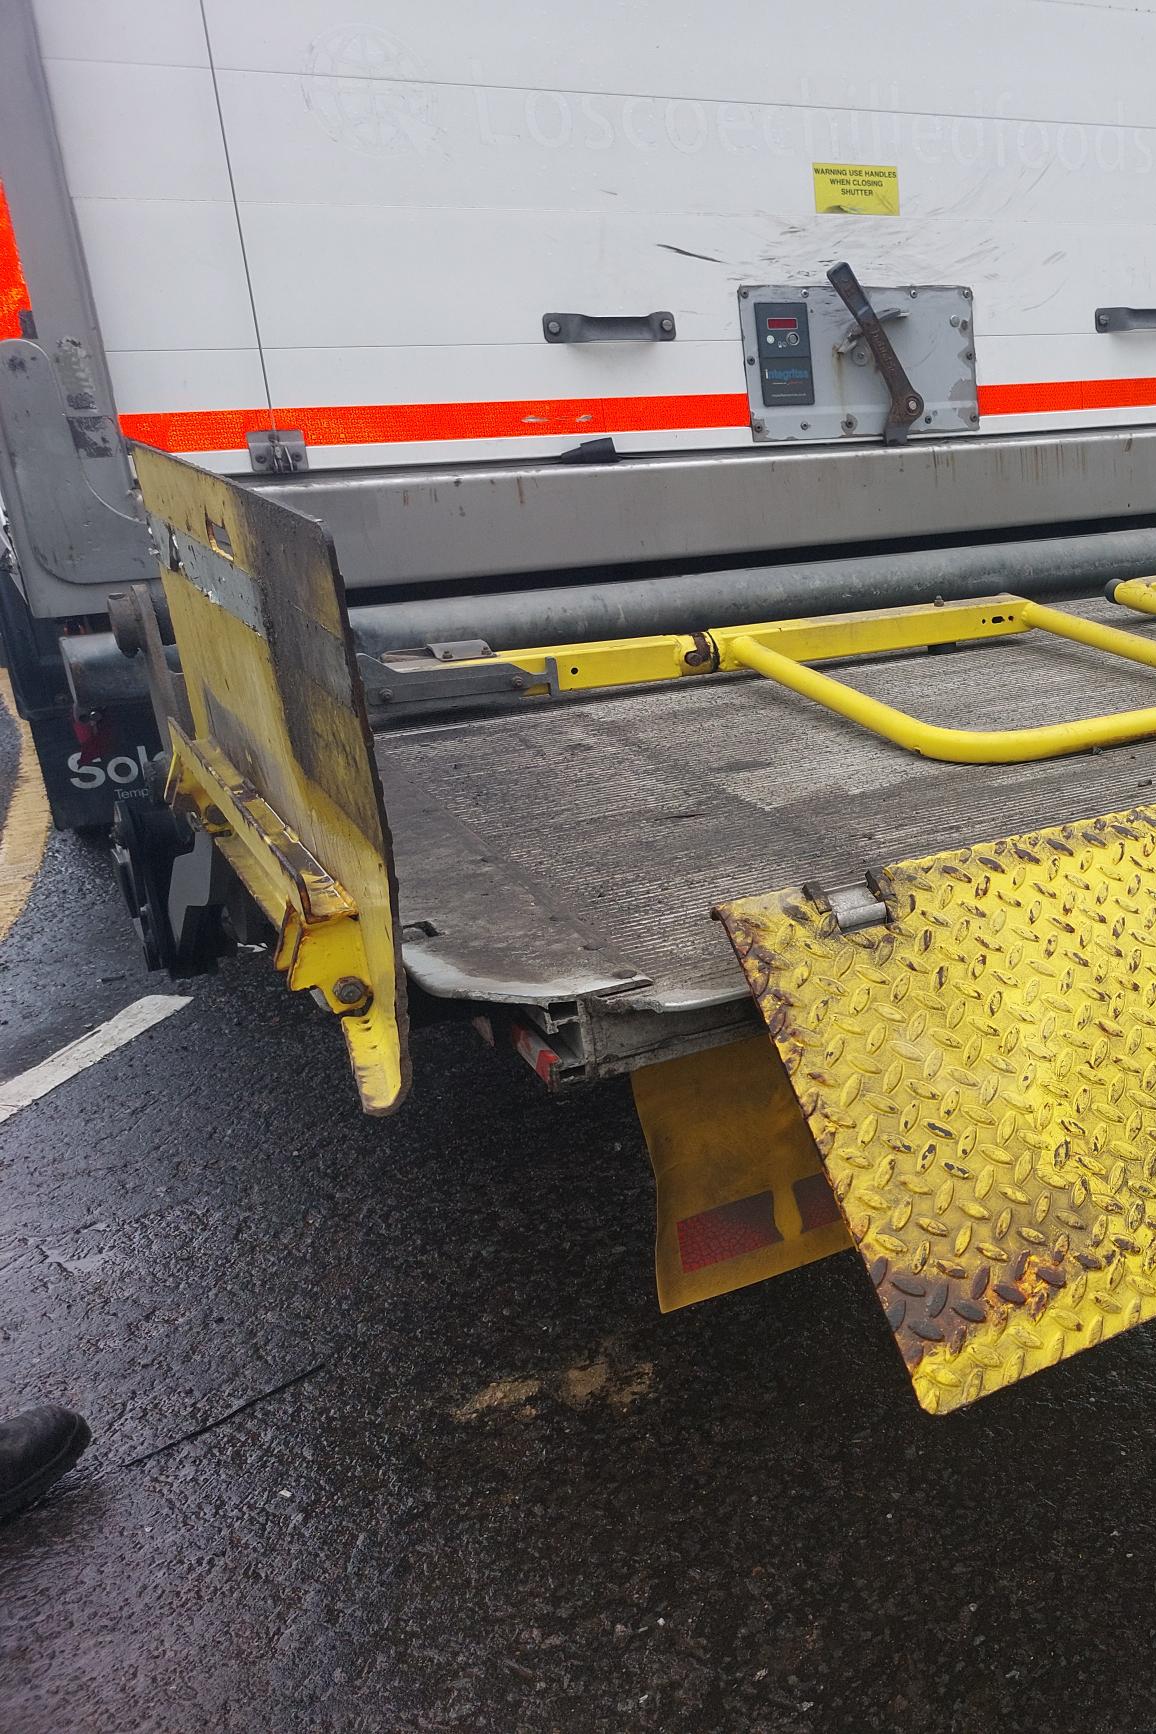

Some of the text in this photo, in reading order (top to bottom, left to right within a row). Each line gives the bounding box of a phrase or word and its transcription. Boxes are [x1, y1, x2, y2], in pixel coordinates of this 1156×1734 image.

[814, 168, 897, 179] WARNING USE HANDLES
[830, 178, 883, 187] WHEN CLOSING
[841, 188, 873, 196] SHUTTER
[67, 745, 167, 789] Sol
